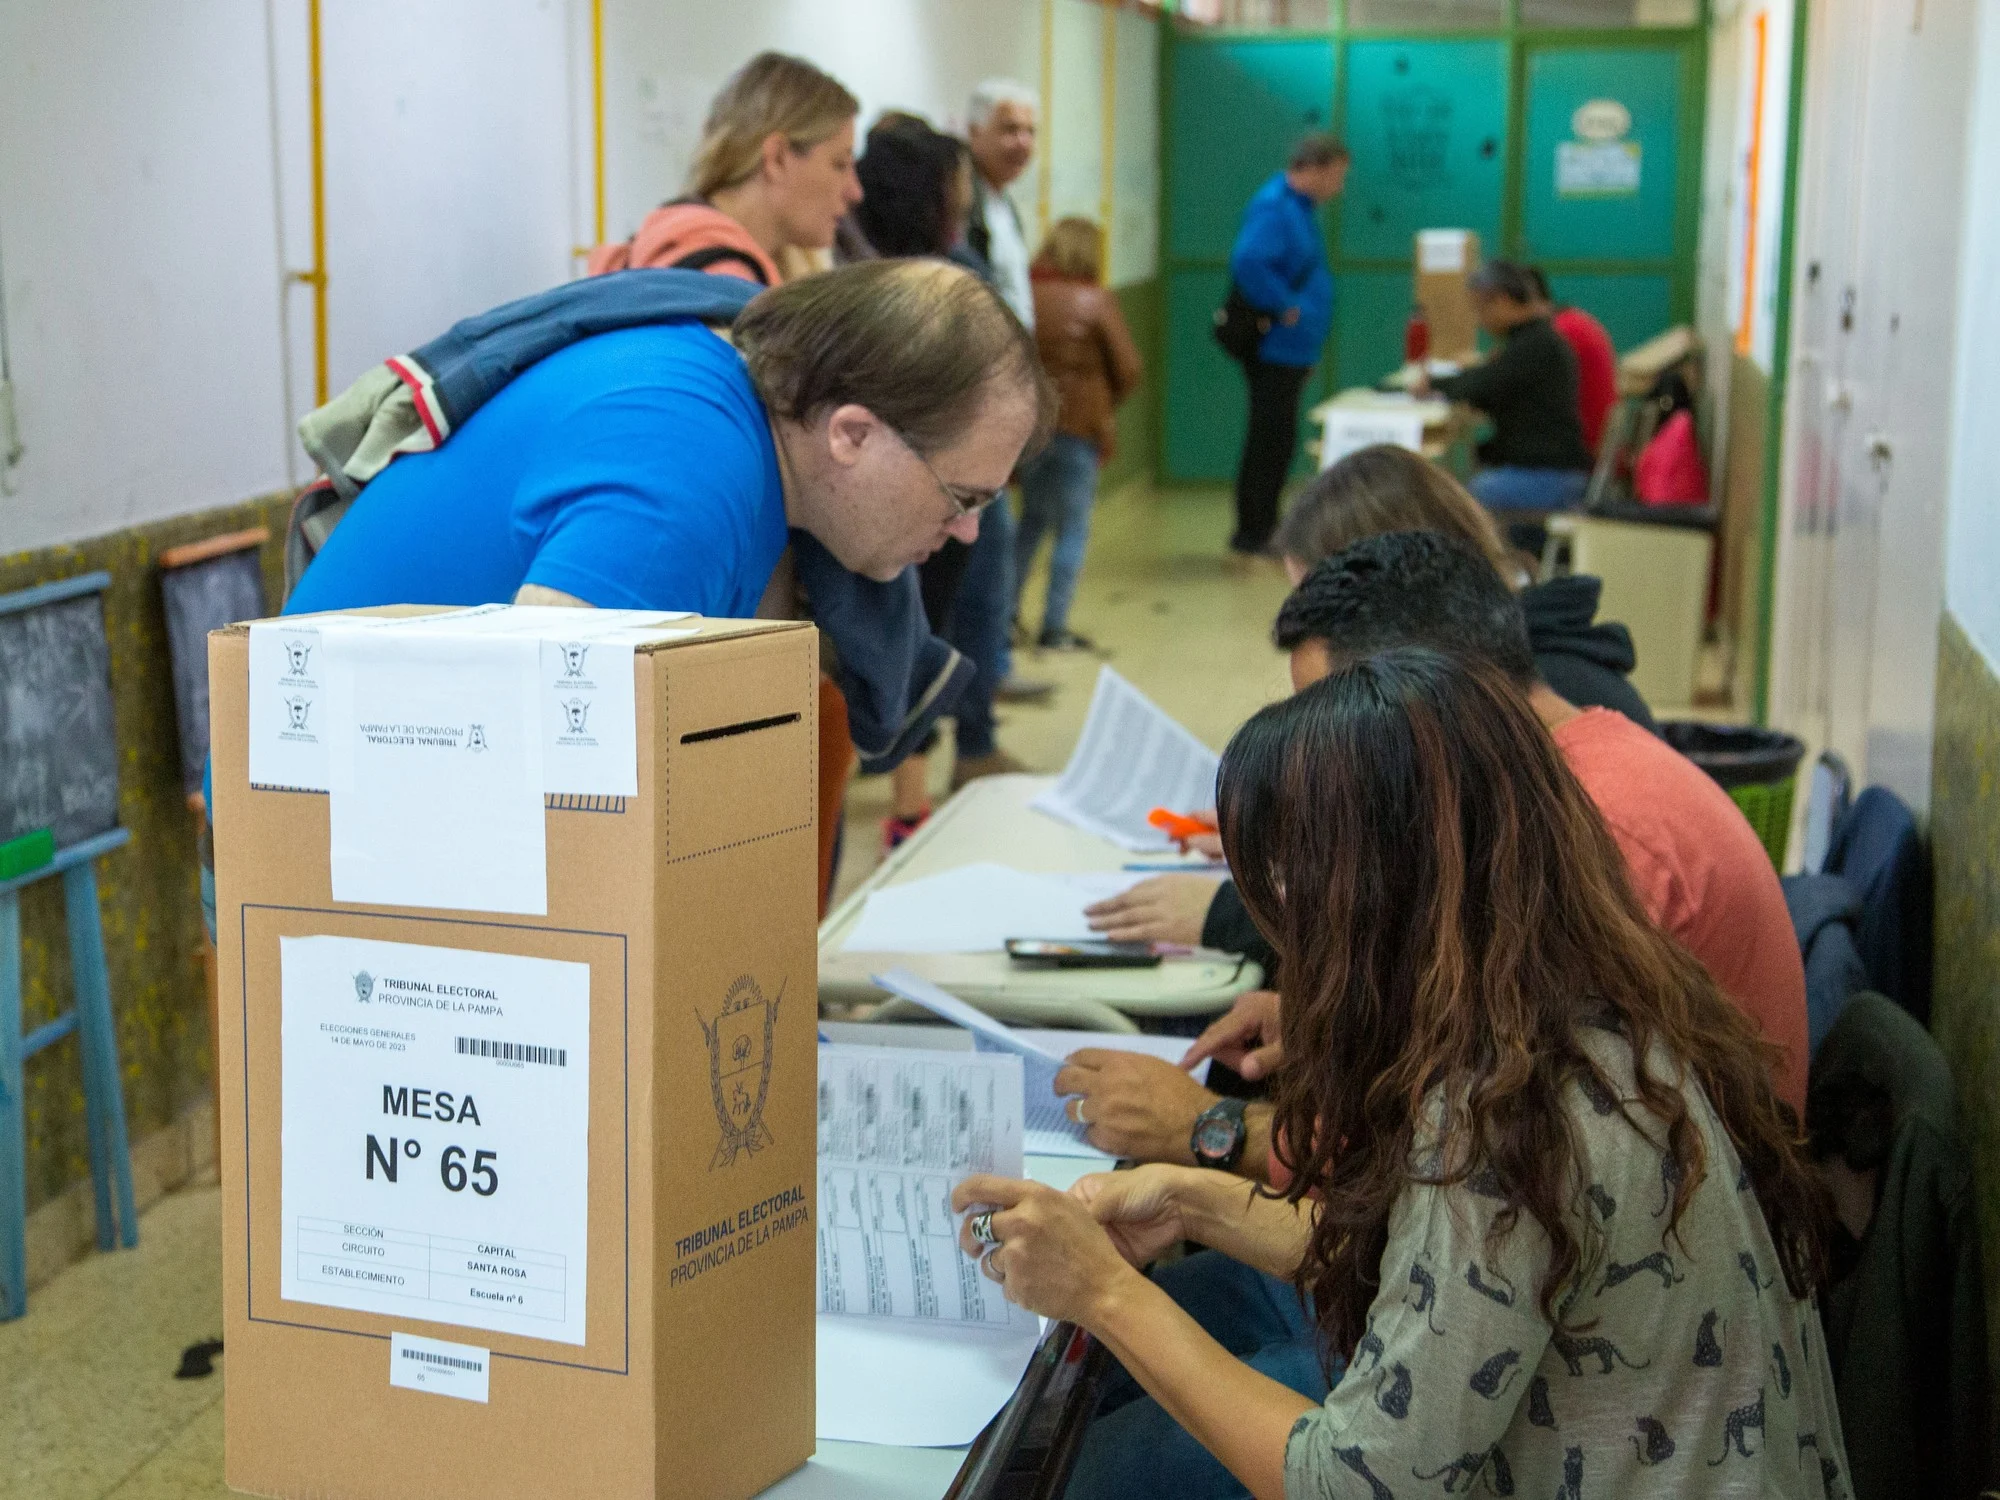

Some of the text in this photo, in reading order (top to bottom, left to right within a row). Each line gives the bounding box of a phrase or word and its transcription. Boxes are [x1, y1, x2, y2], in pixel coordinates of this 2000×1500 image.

[359, 723, 464, 737] PROVINCIA DE LA PAMPA
[366, 735, 457, 747] TRIBUNAL ELECTORAL
[383, 978, 499, 1000] TRIBUNAL ELECTORAL
[378, 993, 504, 1017] PROVINCIA DE LA PAMPA
[320, 1022, 416, 1041] ELECCIONES GENERALES
[331, 1036, 406, 1051] 14 DE MAYO DE 2023
[382, 1084, 482, 1126] MESA
[440, 1145, 499, 1197] 65
[675, 1216, 736, 1260] TRIBUNAL
[738, 1184, 806, 1230] ELECTORAL
[343, 1224, 384, 1239] SECCIÓN
[342, 1242, 385, 1257] CIRCUITO
[477, 1244, 517, 1259] CAPITAL
[670, 1240, 736, 1288] PROVINCIA
[737, 1231, 753, 1255] DE
[756, 1224, 770, 1248] LA
[772, 1205, 809, 1238] PAMPA
[321, 1264, 405, 1286] ESTABLECIMIENTO
[467, 1261, 527, 1279] SANTA ROSA
[470, 1287, 504, 1302] Escuela
[518, 1295, 524, 1305] 6
